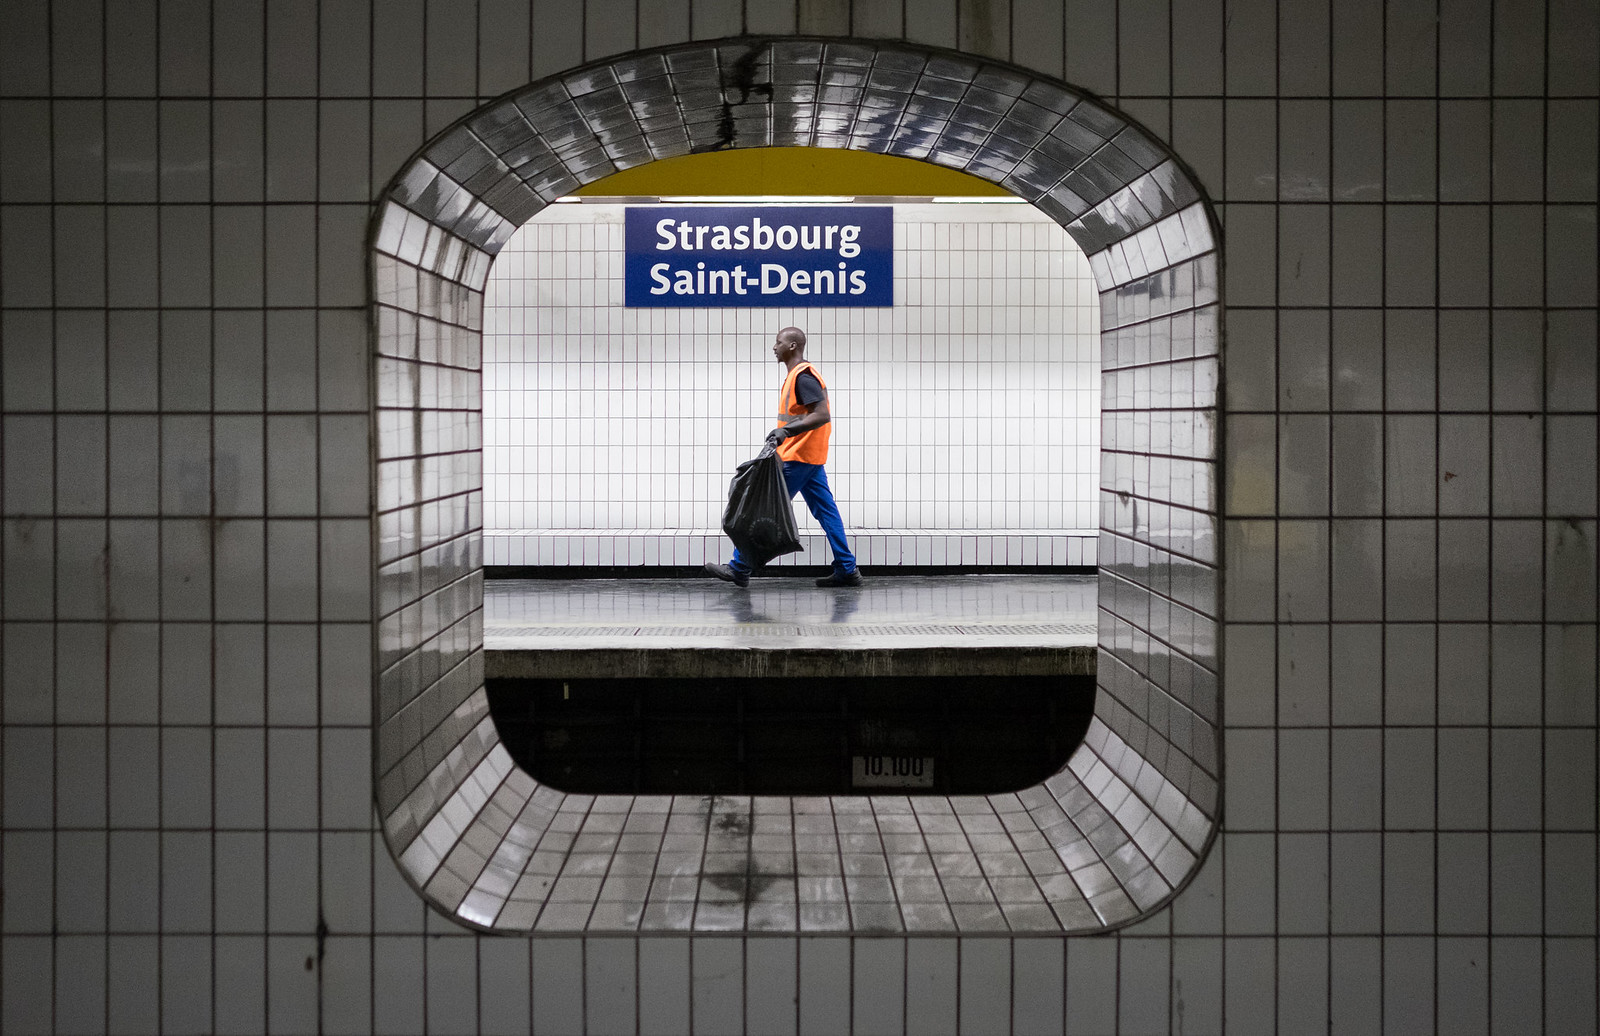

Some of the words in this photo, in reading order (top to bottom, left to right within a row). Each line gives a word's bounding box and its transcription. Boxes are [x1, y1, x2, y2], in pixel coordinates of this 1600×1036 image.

[655, 217, 861, 258] Strasbourg
[649, 262, 867, 295] Saint-Denis
[863, 755, 924, 777] 10.100
